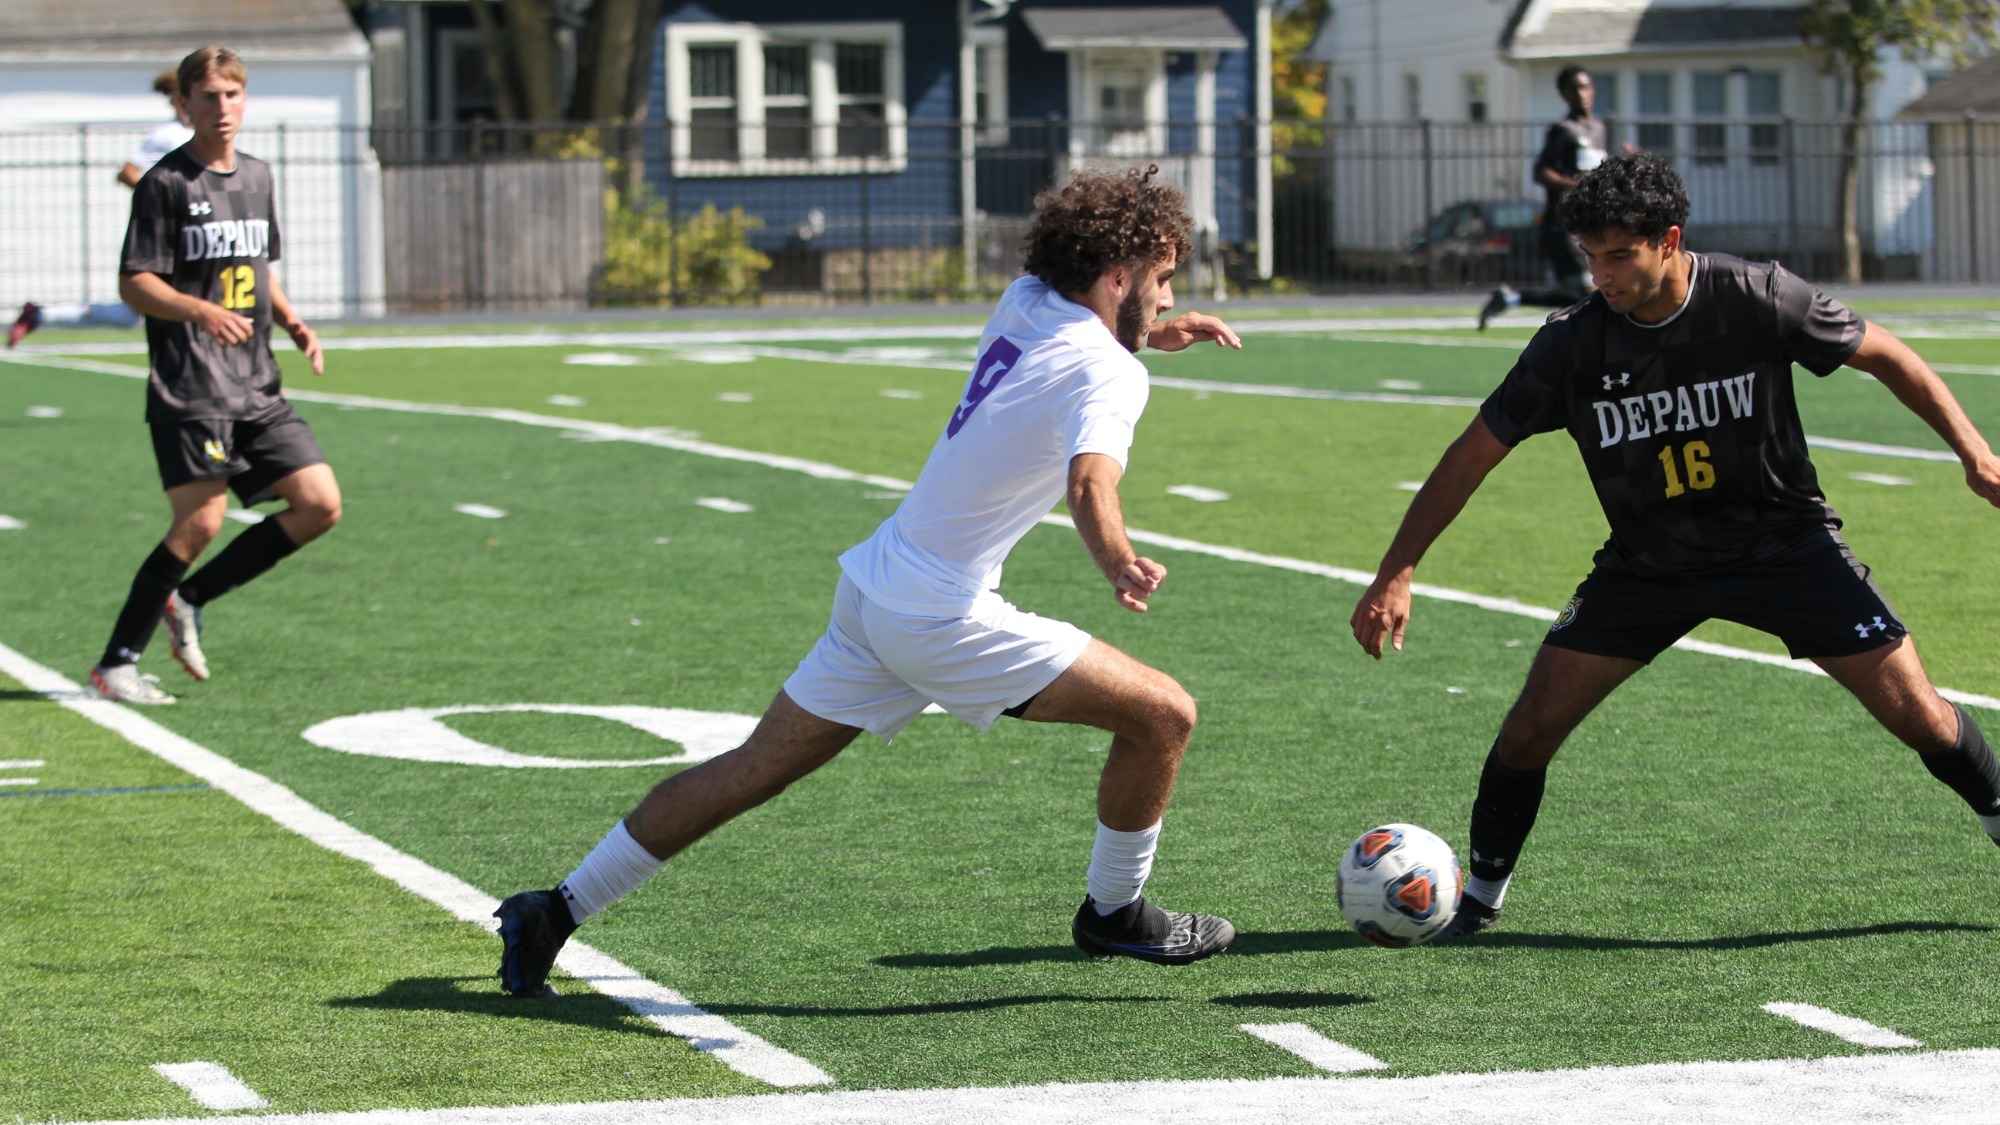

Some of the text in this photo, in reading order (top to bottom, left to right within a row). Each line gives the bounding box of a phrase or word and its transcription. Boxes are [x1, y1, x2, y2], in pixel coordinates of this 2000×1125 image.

[219, 264, 256, 309] 12
[946, 335, 1023, 441] 9
[1592, 371, 1756, 449] DEPAUW
[1657, 440, 1716, 499] 16
